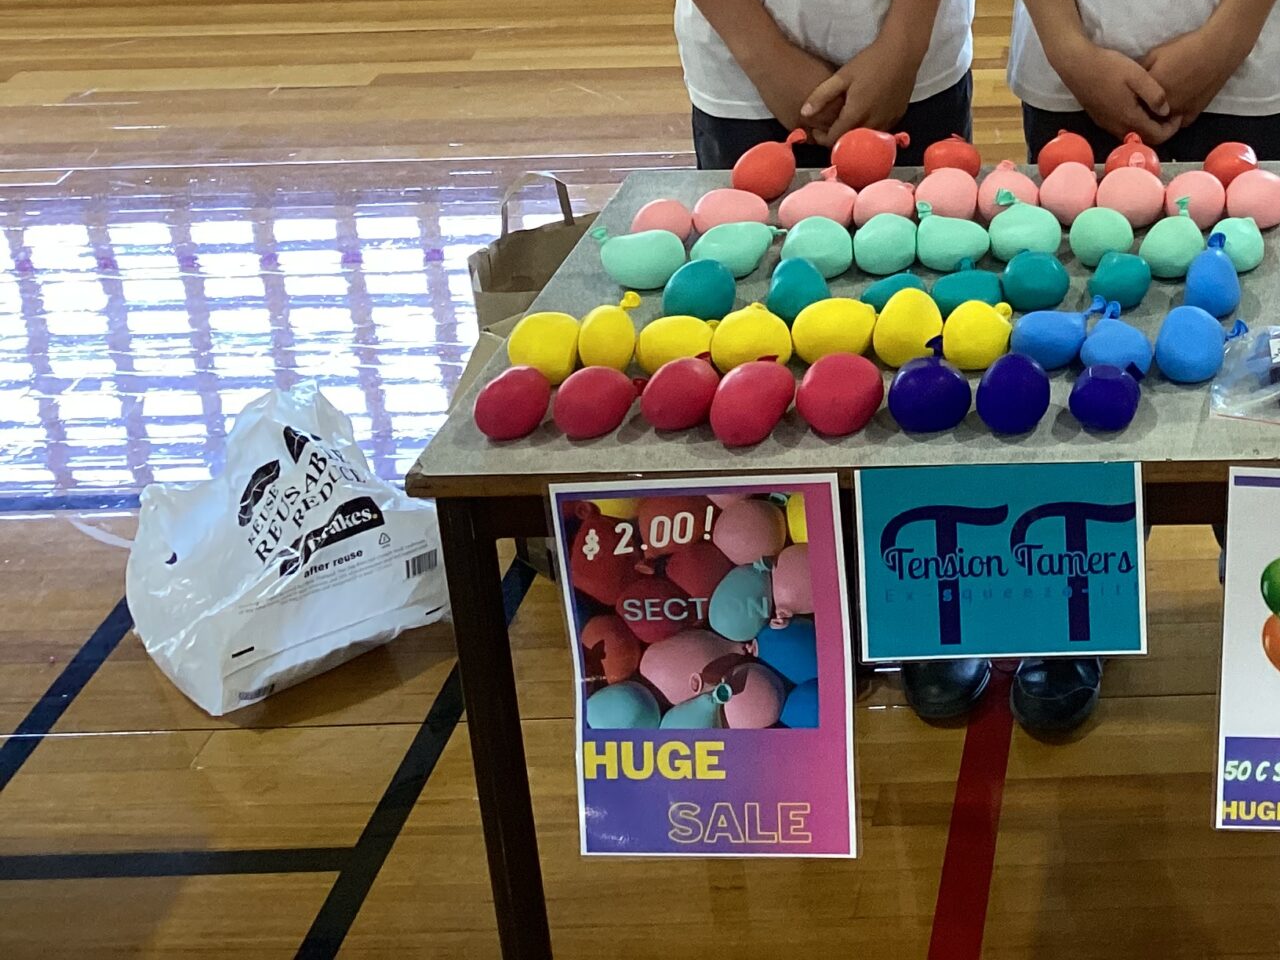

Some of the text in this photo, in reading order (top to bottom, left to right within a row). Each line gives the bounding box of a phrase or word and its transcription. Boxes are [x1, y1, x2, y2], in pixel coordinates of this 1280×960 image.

[303, 560, 331, 579] after
[332, 550, 364, 566] reuse
[883, 543, 1135, 581] Tension Tamers
[622, 596, 770, 622] SECTN
[584, 741, 726, 780] HUGE
[1224, 760, 1251, 781] 50
[1255, 760, 1270, 782] C
[668, 802, 813, 844] SALE
